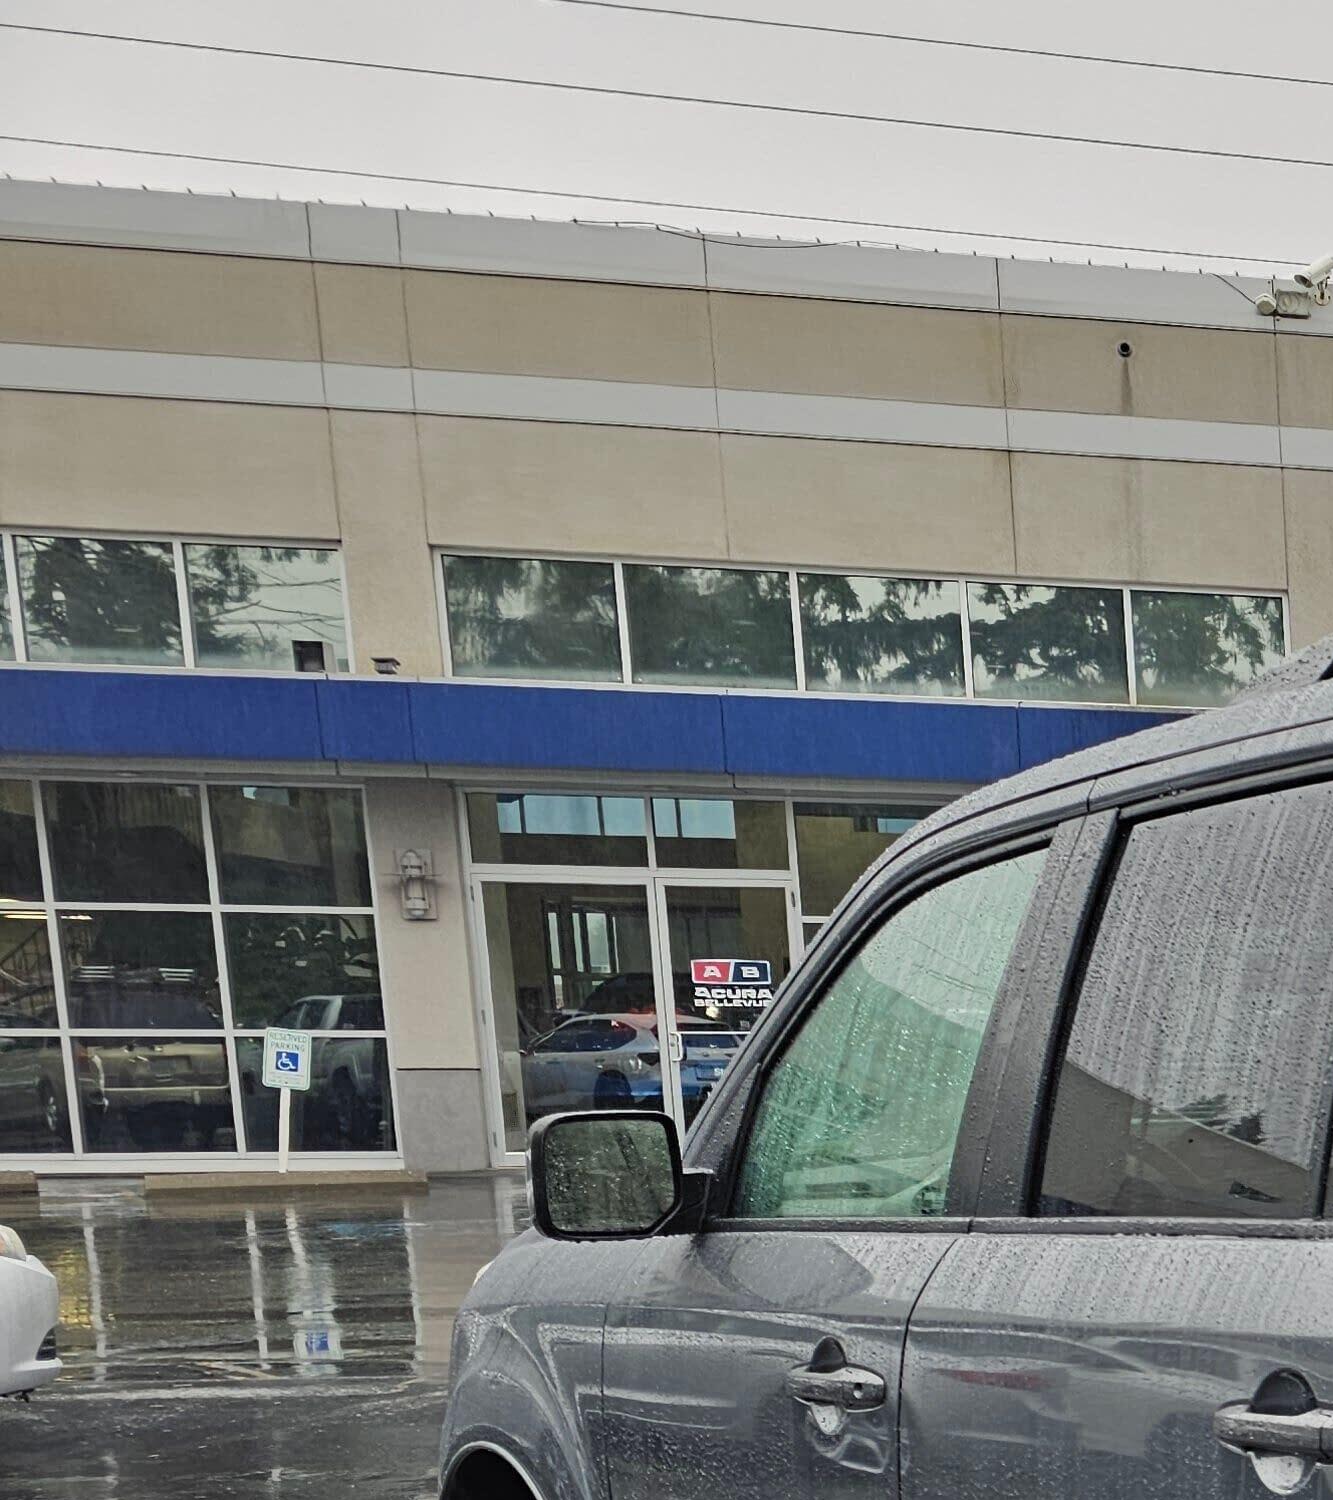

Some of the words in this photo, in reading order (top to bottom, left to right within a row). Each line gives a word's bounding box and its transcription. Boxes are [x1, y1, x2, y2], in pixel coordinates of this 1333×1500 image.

[703, 966, 721, 978] A
[740, 966, 760, 978] B
[694, 986, 773, 999] ACURA
[269, 1031, 307, 1043] RESERVED
[270, 1041, 305, 1052] PARKING
